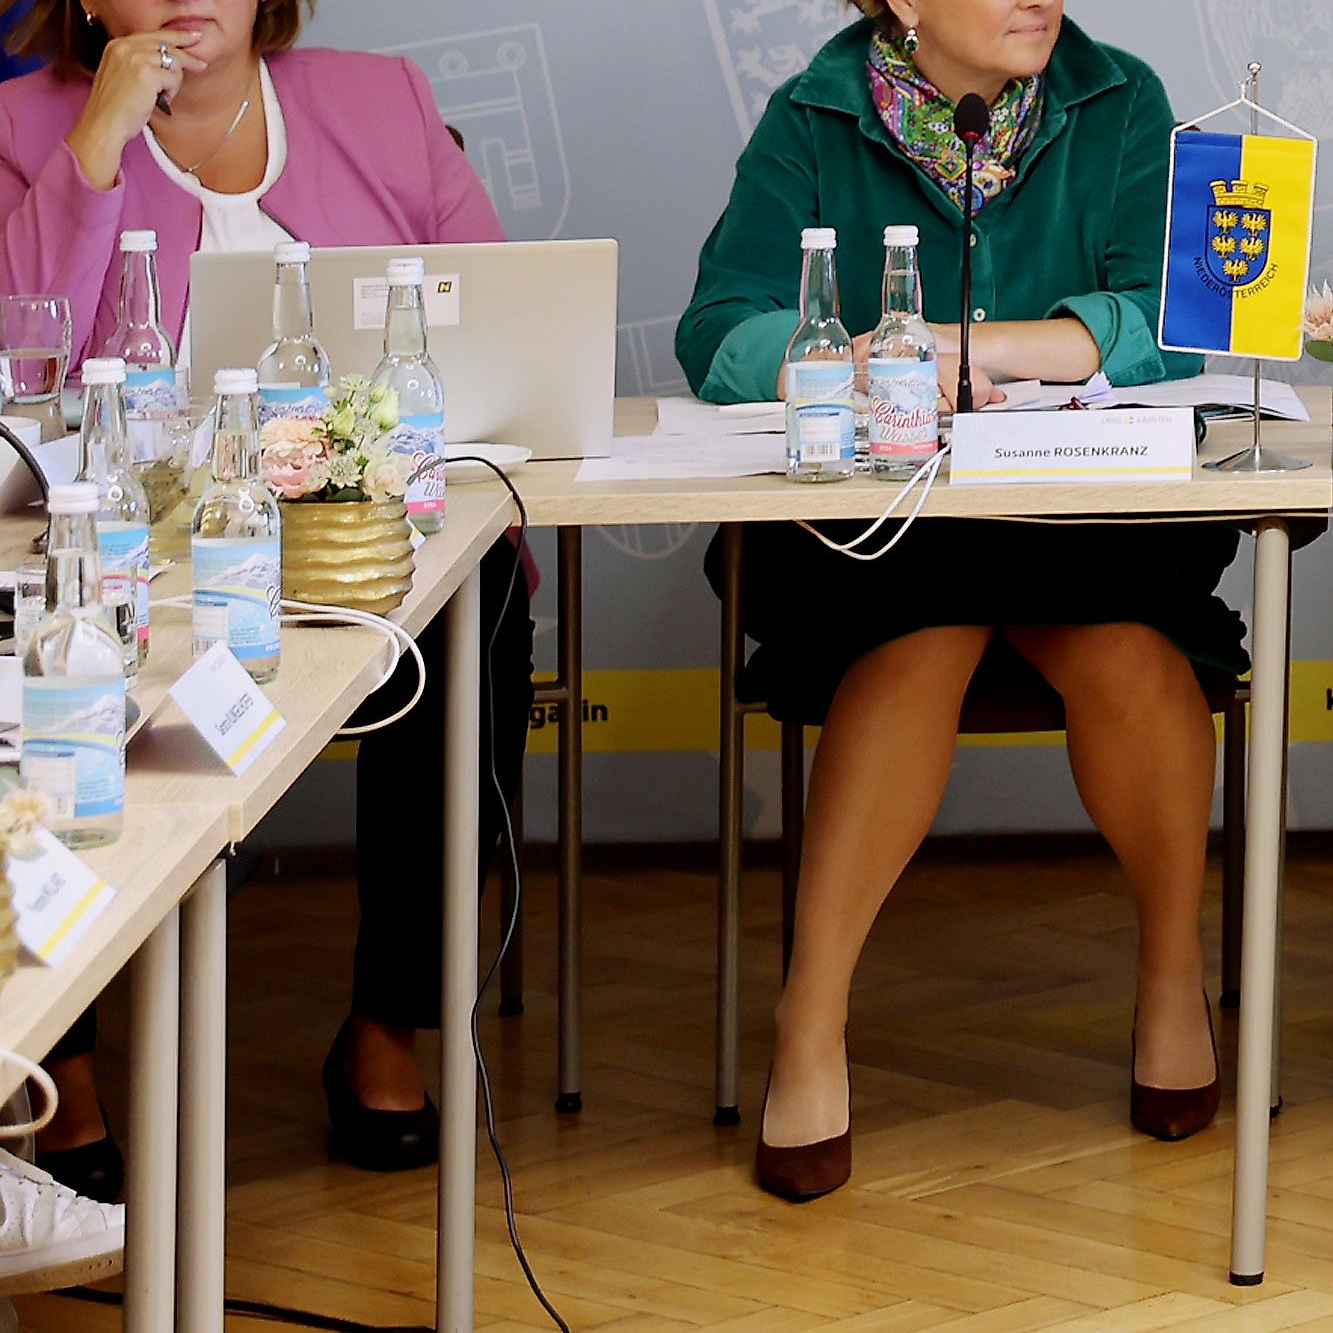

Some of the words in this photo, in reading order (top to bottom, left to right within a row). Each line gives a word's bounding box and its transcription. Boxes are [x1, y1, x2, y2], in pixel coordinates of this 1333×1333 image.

[1193, 256, 1278, 299] NIEDERÖSTERREICH
[995, 447, 1051, 459] Susanne
[1053, 445, 1149, 458] ROSENKRANZ
[529, 698, 608, 730] gain
